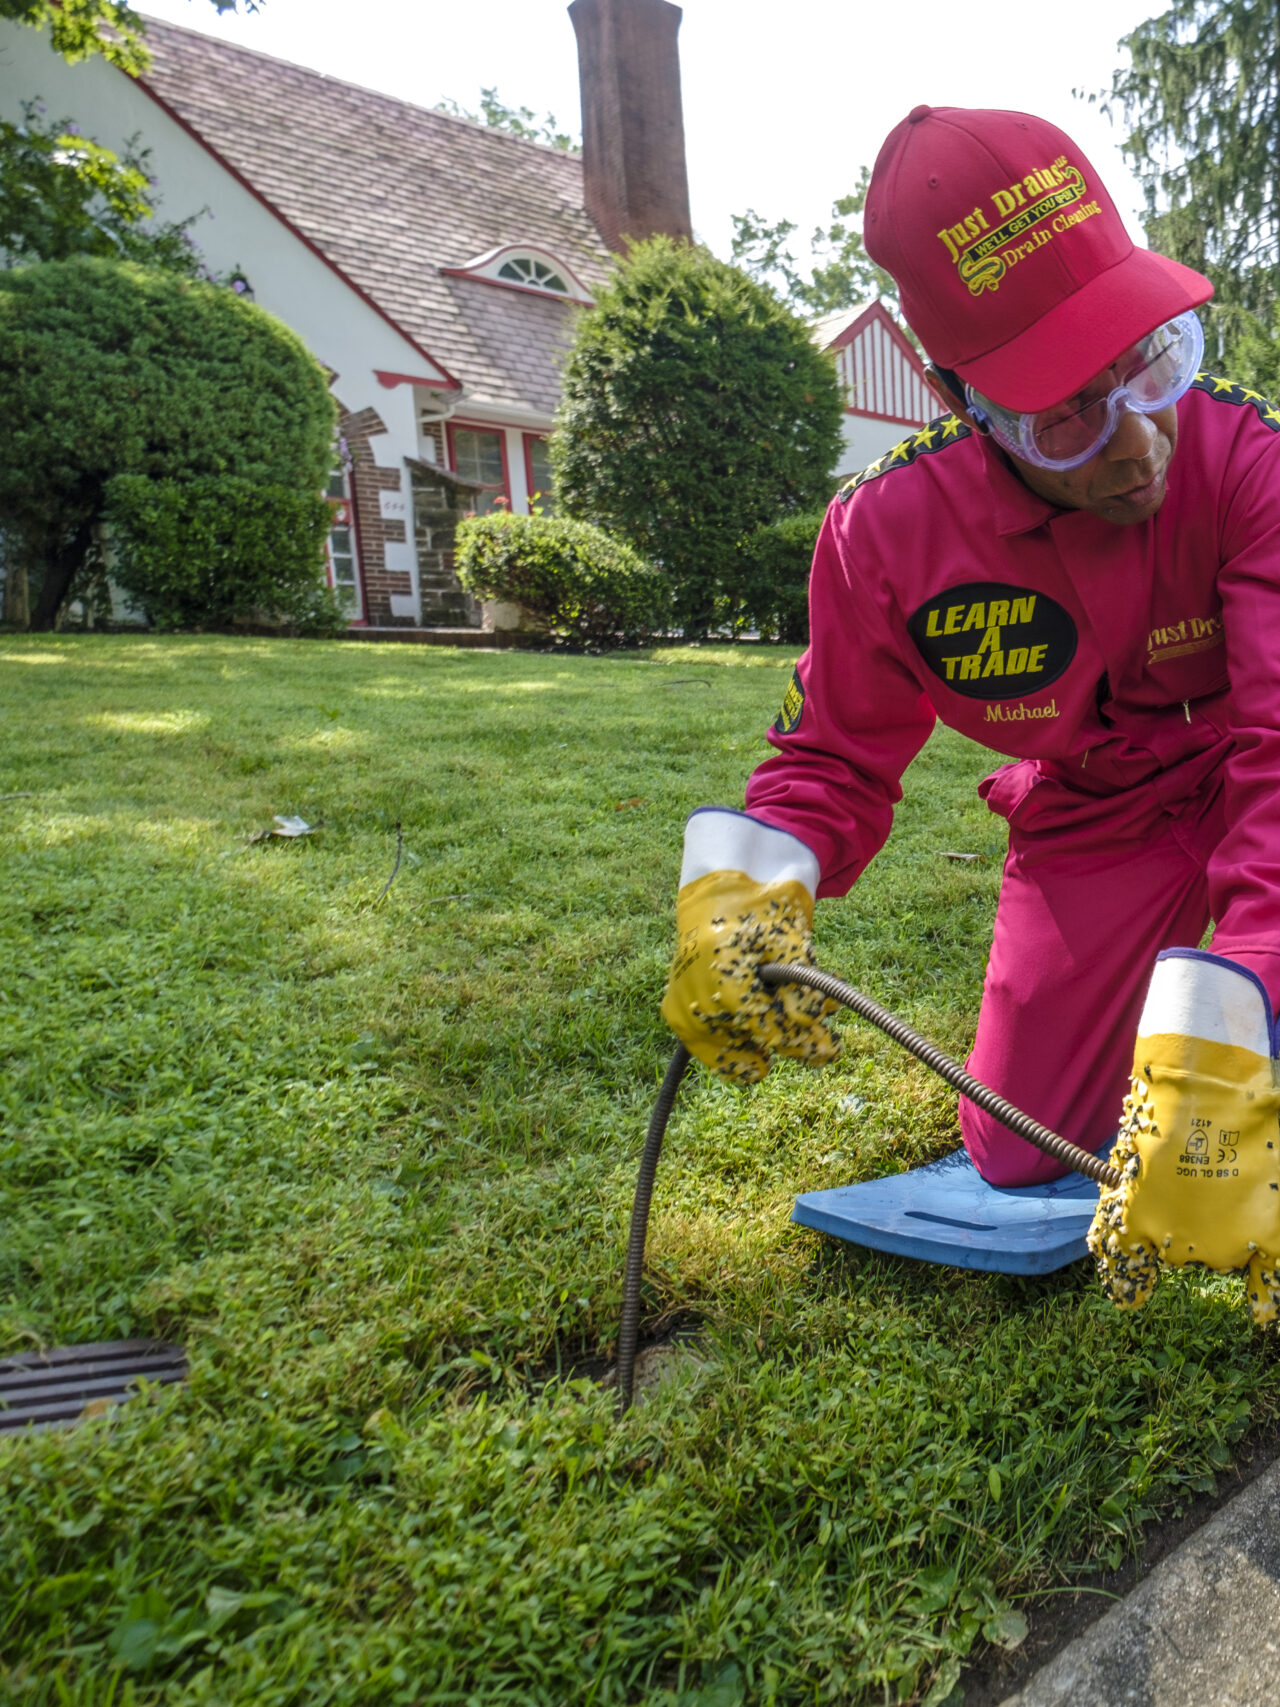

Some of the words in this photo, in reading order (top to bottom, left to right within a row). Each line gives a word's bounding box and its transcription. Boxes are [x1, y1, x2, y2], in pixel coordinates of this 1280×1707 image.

[937, 207, 990, 263] Just
[991, 164, 1065, 217] Drains
[974, 230, 1009, 257] WE'LL
[1009, 213, 1033, 233] GET
[1032, 197, 1056, 217] YOU
[1001, 230, 1053, 268] Drain
[1052, 200, 1102, 232] Cleaning
[925, 595, 1037, 637] LEARN
[1187, 617, 1220, 638] Dr
[977, 626, 1000, 654] A
[941, 643, 1049, 680] TRADE
[983, 698, 1060, 723] Michael
[1191, 1118, 1212, 1128] 4121
[1176, 1167, 1197, 1177] UGC
[1179, 1155, 1210, 1165] EN388
[1200, 1168, 1214, 1178] GL
[1216, 1168, 1230, 1178] SB
